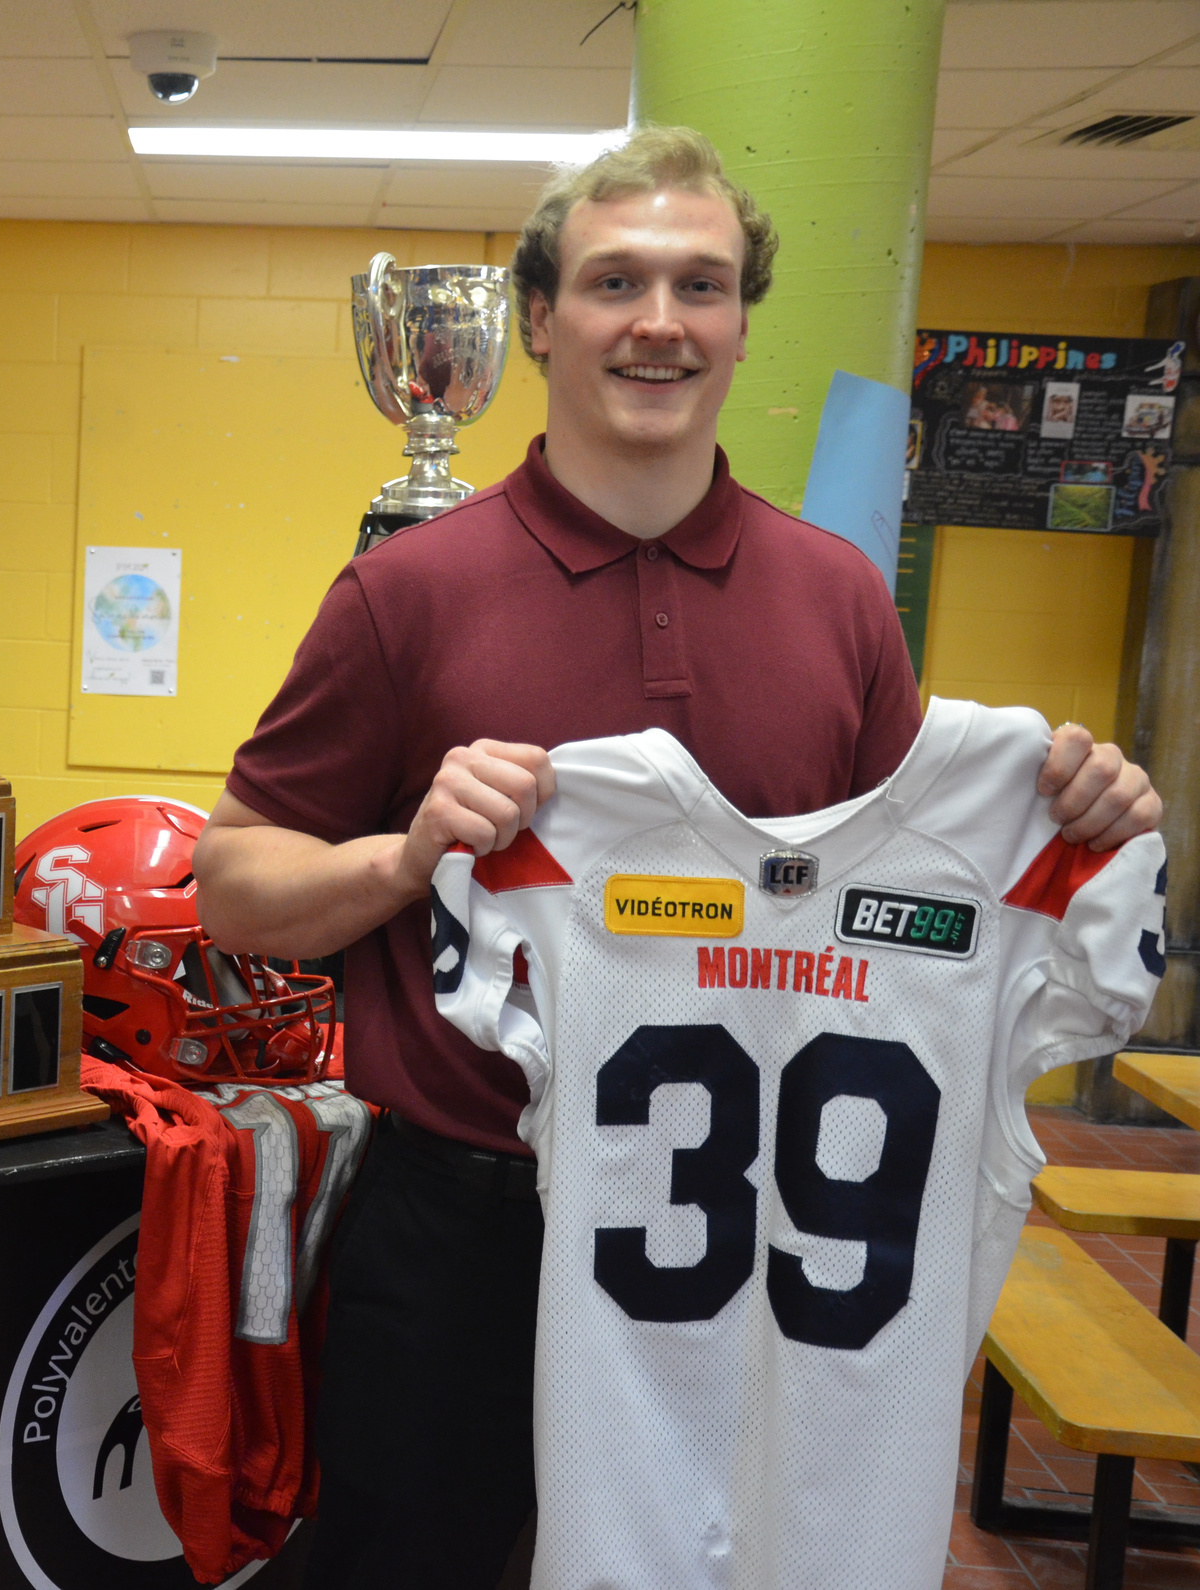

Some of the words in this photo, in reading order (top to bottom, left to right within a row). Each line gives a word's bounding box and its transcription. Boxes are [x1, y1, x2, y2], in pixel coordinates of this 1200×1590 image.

[942, 334, 1118, 370] Philippines
[768, 863, 809, 886] LCF
[615, 896, 734, 920] VIDÉOTRON
[697, 945, 870, 1003] MONTRÉAL
[594, 1022, 942, 1350] 39
[22, 1251, 137, 1444] Polyvalent
